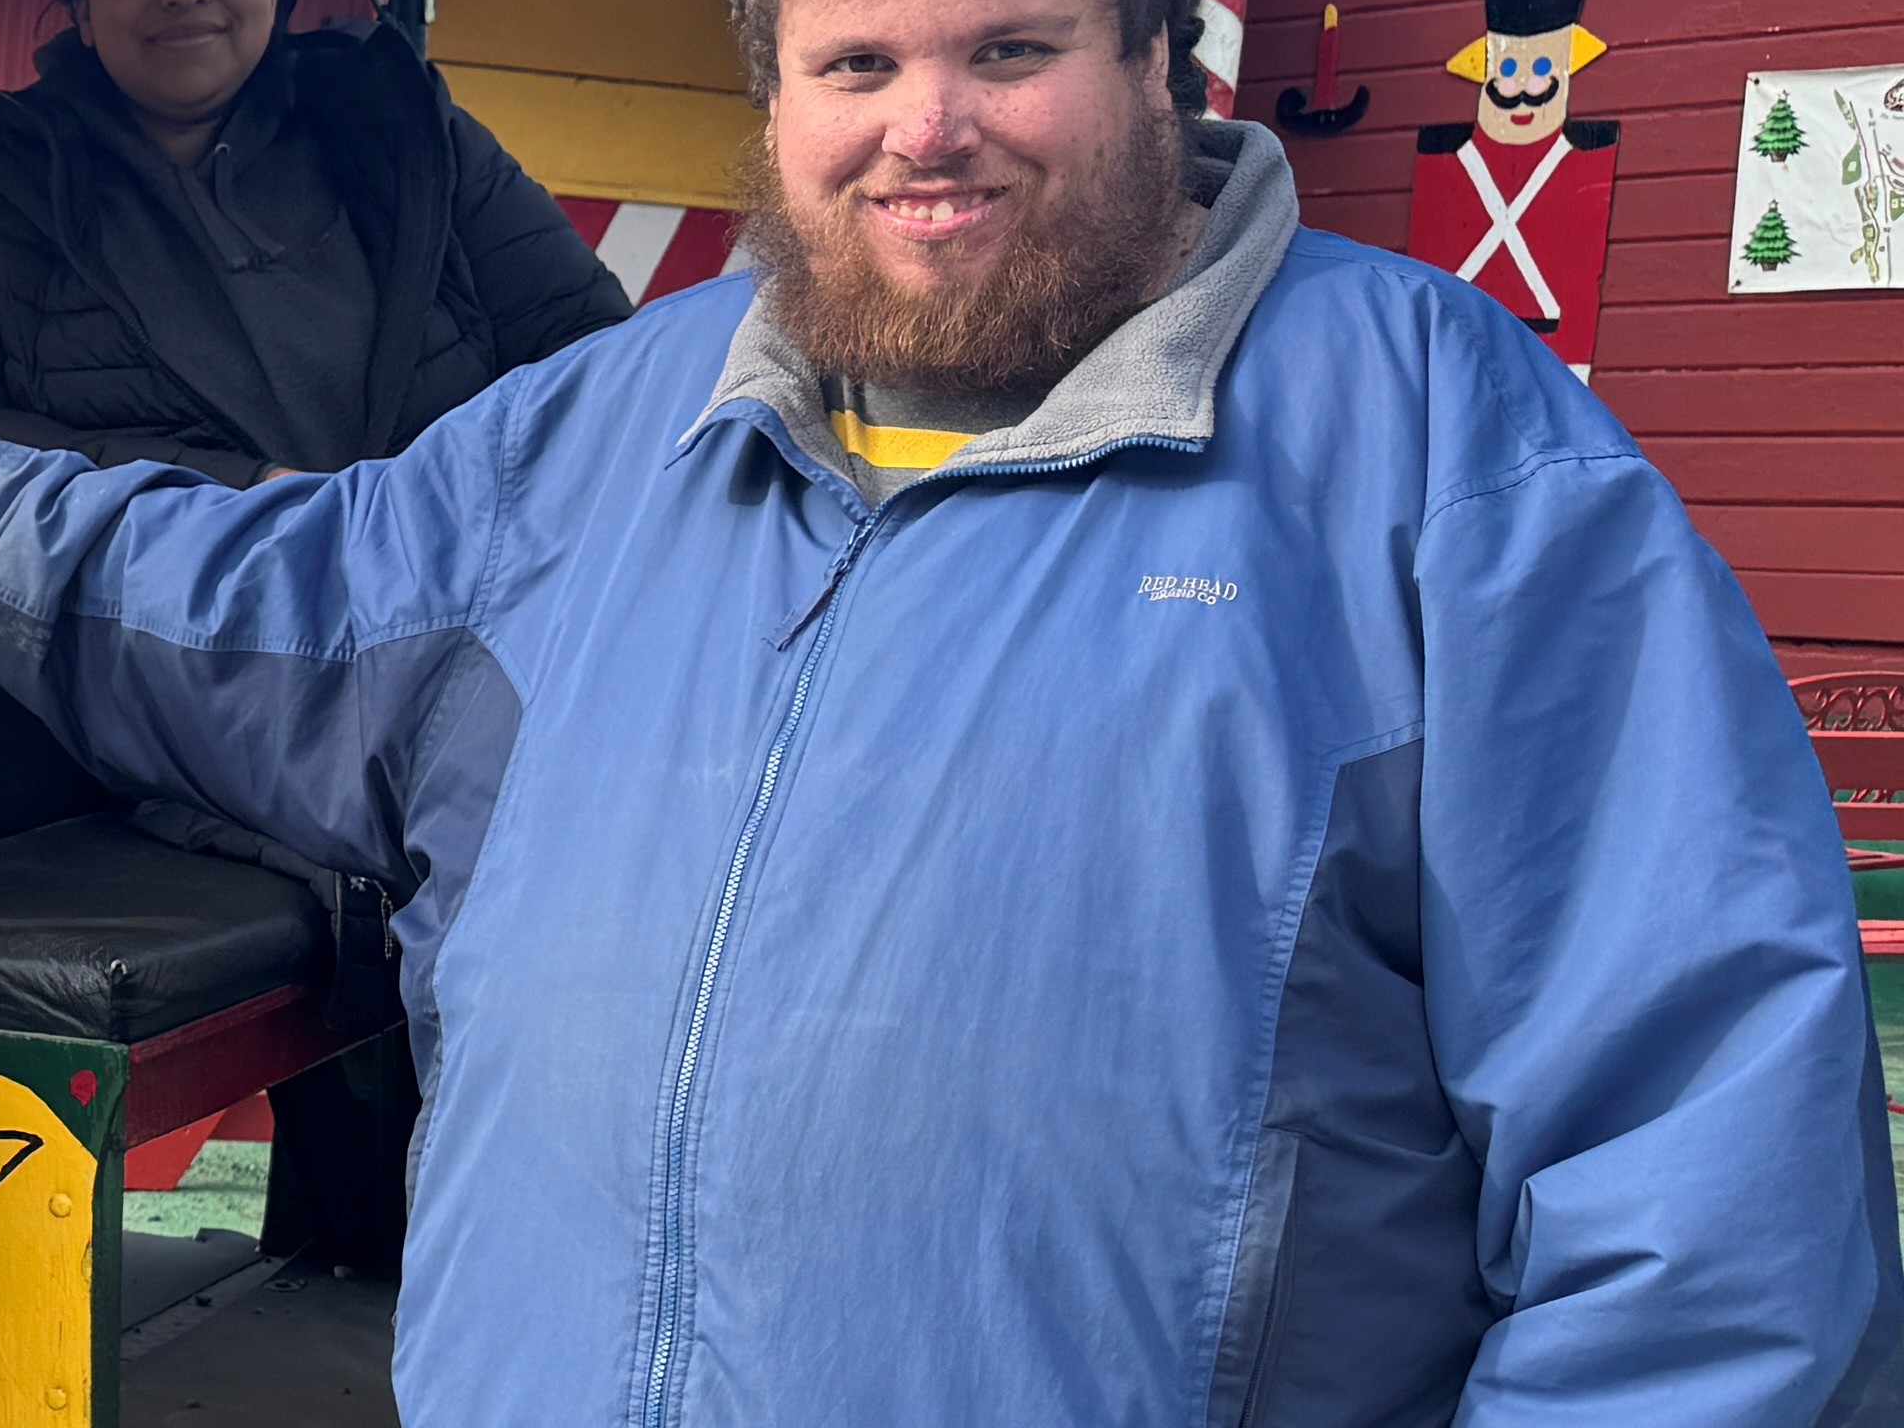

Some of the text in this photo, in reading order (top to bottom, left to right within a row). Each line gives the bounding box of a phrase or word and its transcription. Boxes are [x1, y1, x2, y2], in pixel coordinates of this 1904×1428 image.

[1137, 575, 1238, 601] RED HEAD
[1149, 587, 1196, 602] BRAND
